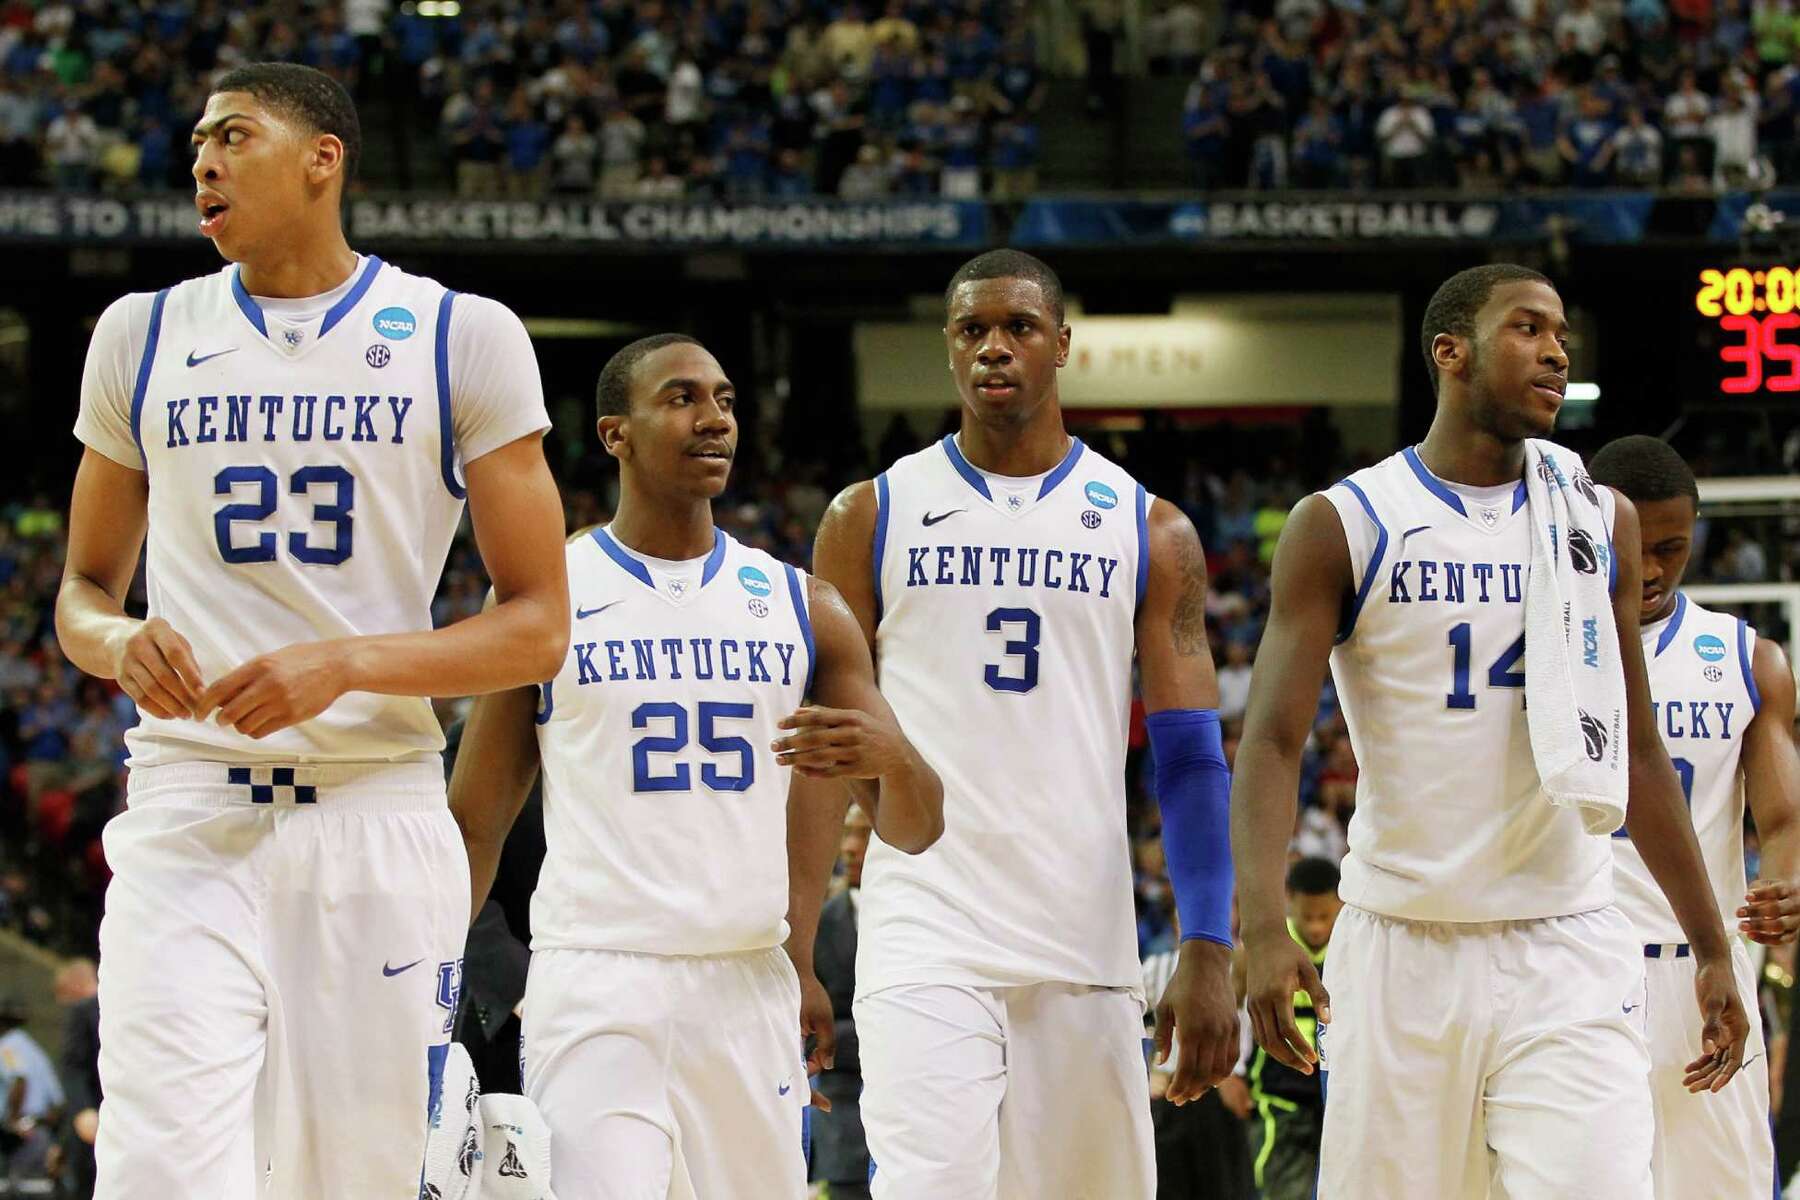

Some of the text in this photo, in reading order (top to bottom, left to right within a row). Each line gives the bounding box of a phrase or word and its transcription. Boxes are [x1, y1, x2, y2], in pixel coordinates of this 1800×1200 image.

[66, 199, 127, 236] TO
[352, 201, 619, 239] BASKETBALL
[623, 202, 960, 240] CHAMPIONSHIPS
[1209, 203, 1458, 237] BASKETBALL
[1697, 266, 1800, 317] 20:0
[366, 344, 391, 368] SEC
[1720, 312, 1800, 393] 35
[166, 395, 413, 449] KENTUCKY
[214, 465, 355, 566] 23
[1081, 510, 1101, 529] SEC
[906, 545, 1118, 599] KENTUCKY
[1388, 561, 1529, 603] KENTU
[573, 638, 795, 686] KENTUCKY
[983, 607, 1041, 694] 3
[1582, 617, 1599, 668] NCAA
[632, 701, 754, 792] 25
[1611, 708, 1621, 761] BASKETBALL
